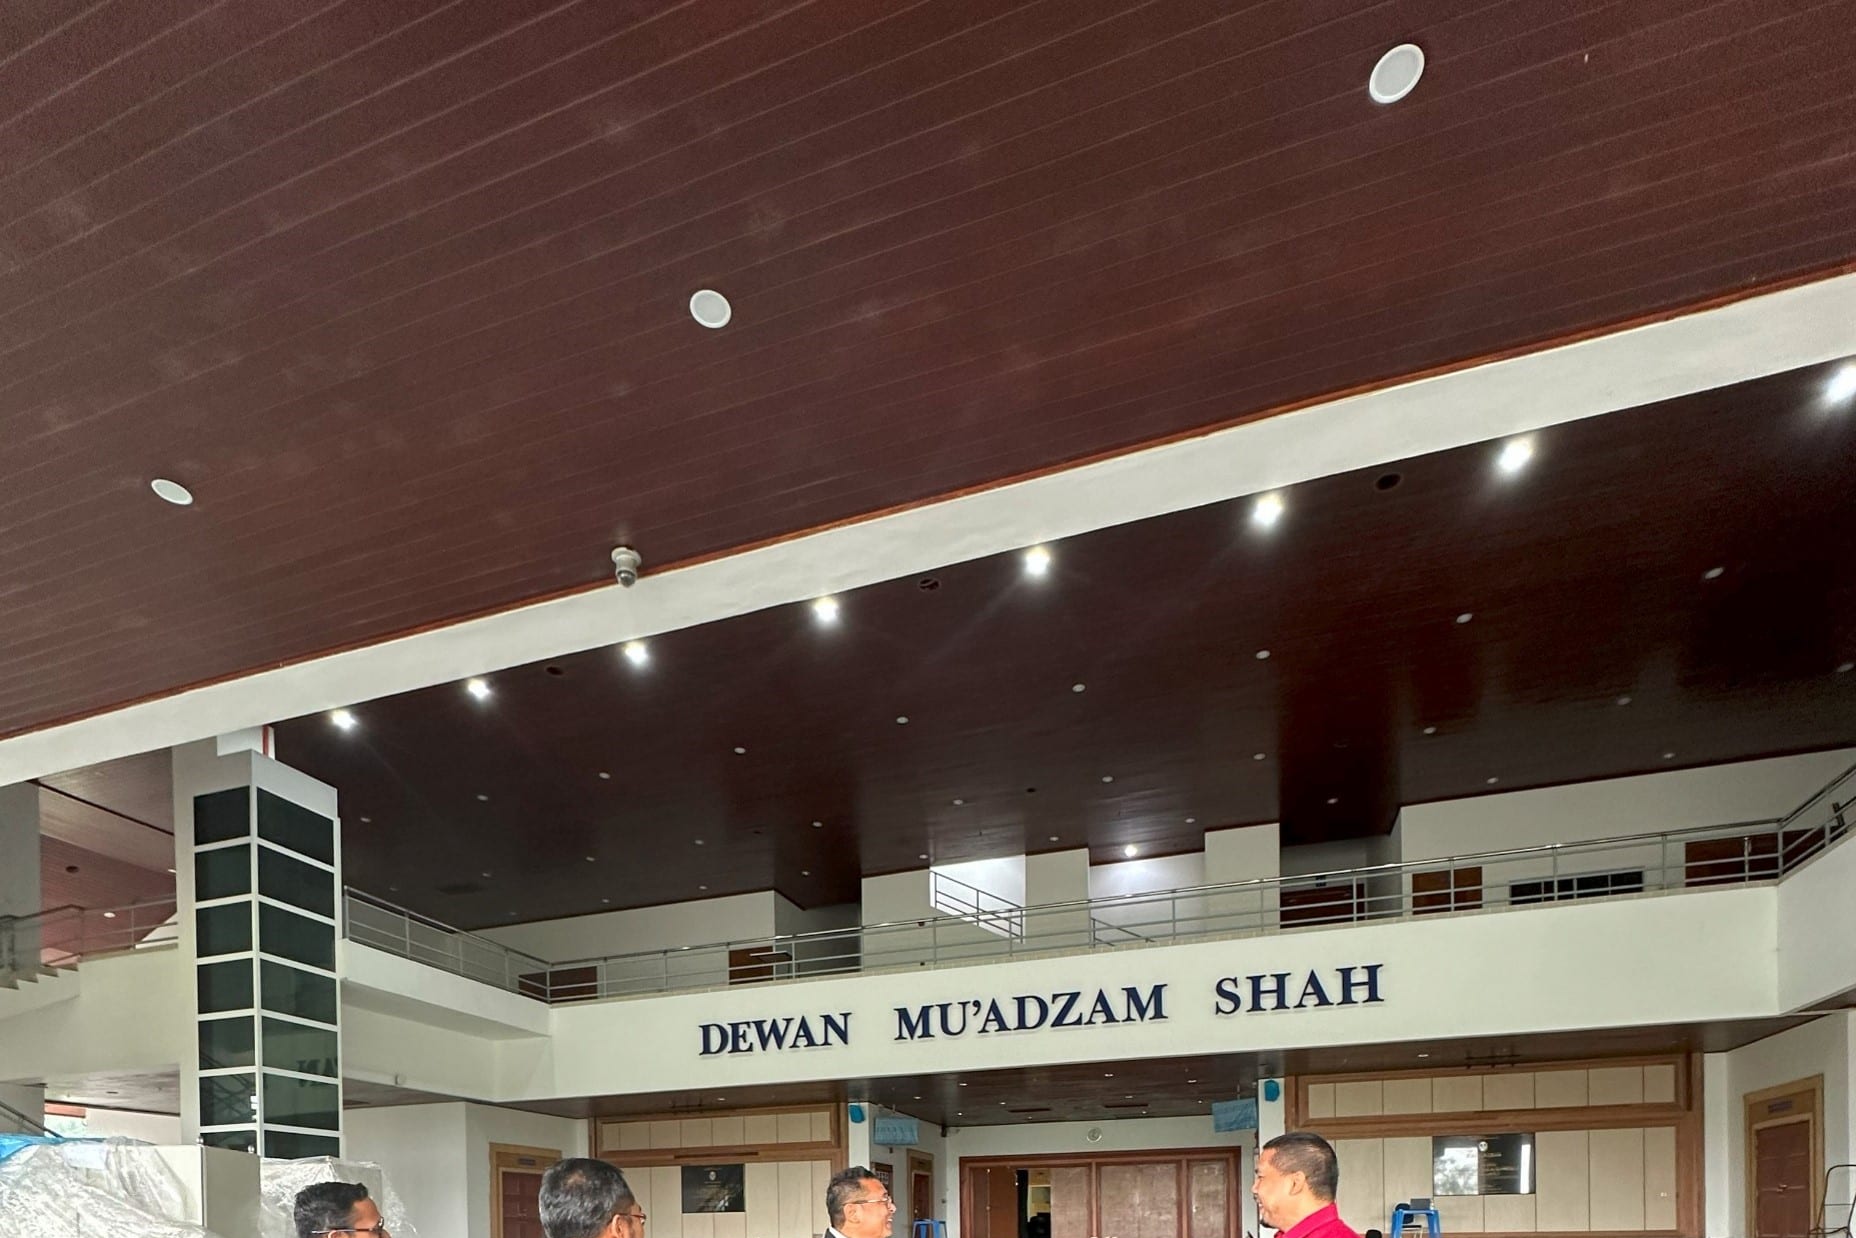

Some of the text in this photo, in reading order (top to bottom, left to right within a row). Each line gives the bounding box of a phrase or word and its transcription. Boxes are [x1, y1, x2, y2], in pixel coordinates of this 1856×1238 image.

[698, 964, 1385, 1056] DEWAN MU'ADZAM SHAH
